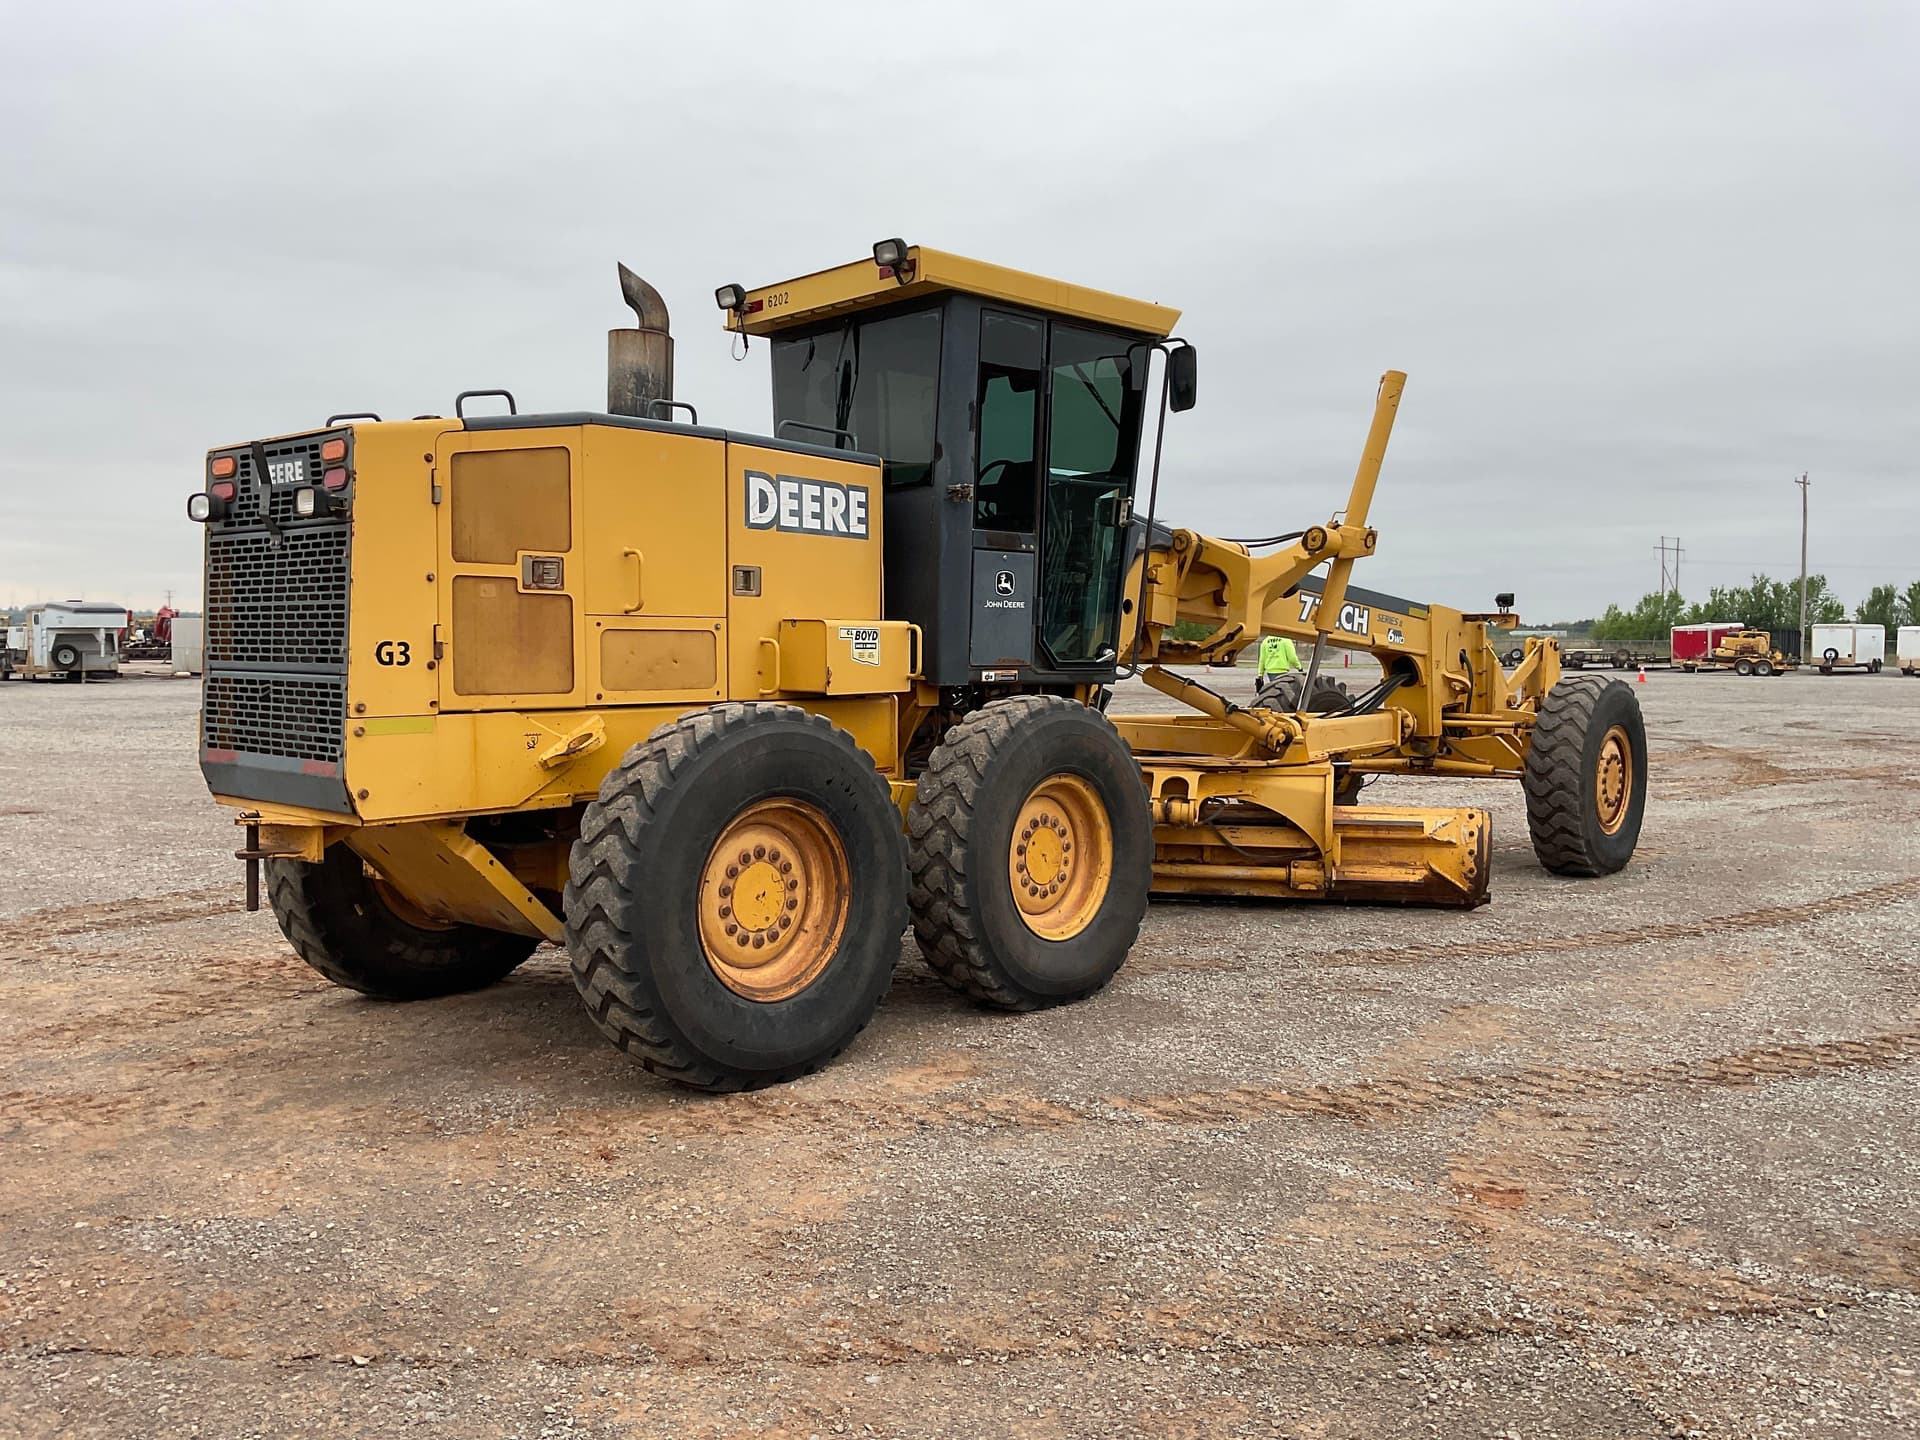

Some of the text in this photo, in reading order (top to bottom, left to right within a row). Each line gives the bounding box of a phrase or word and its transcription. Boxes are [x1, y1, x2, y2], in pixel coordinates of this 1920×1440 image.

[768, 292, 788, 308] 6202
[258, 461, 304, 485] EERE
[747, 474, 867, 536] DEERE
[984, 600, 1025, 608] JOHN DEERE
[1299, 593, 1369, 635] 7CH
[854, 630, 878, 641] BOYD
[375, 641, 411, 666] G3
